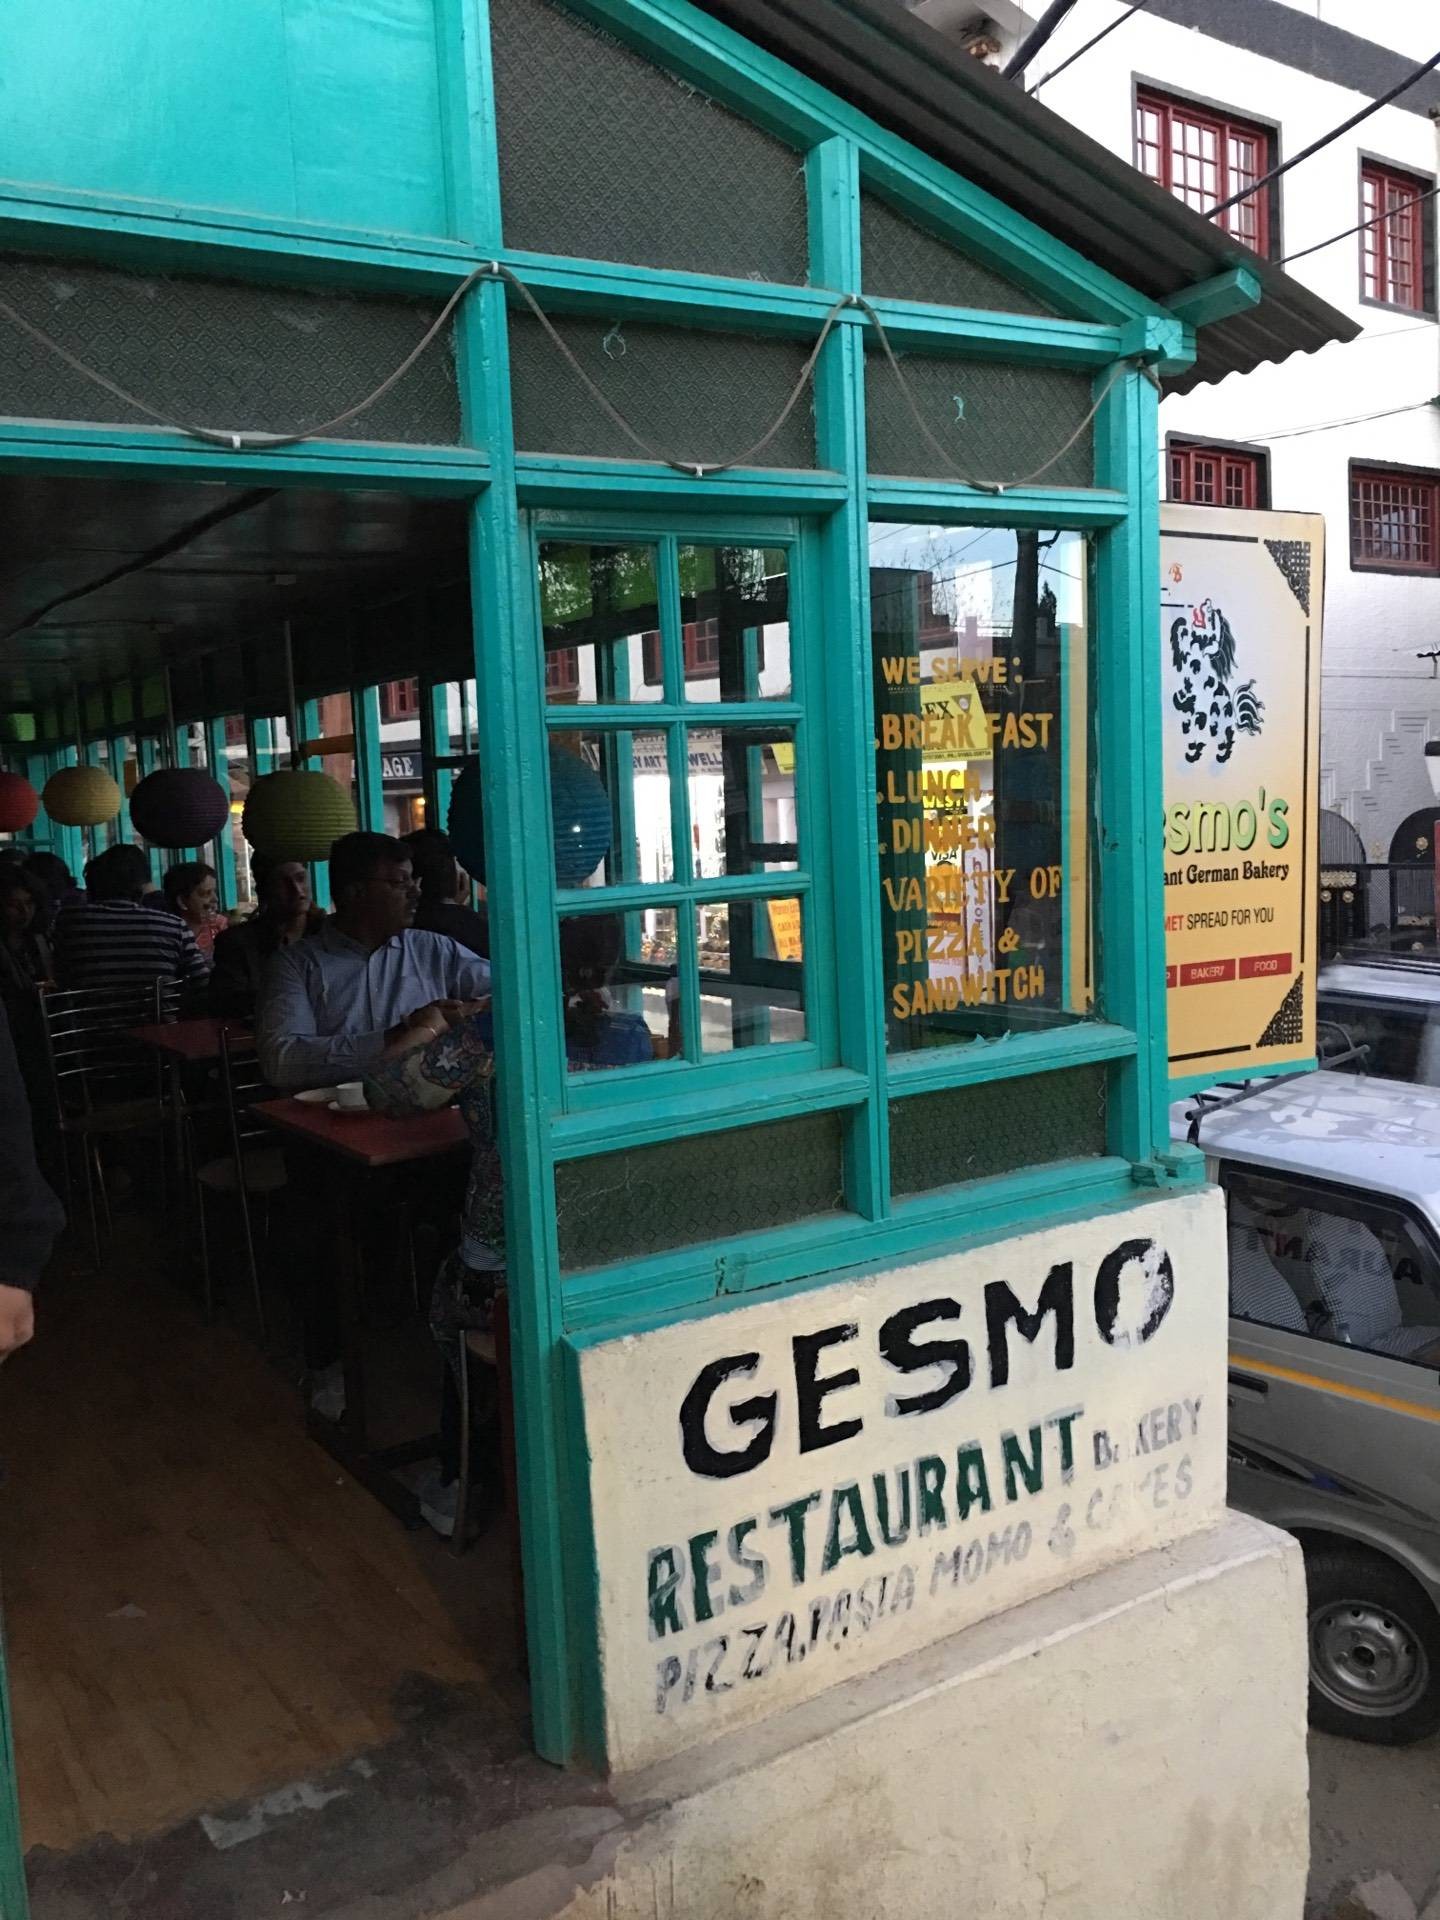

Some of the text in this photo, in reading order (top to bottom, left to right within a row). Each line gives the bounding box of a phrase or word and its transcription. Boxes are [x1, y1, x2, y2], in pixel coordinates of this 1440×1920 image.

[882, 657, 920, 684] WE
[644, 755, 662, 768] ART
[887, 768, 980, 804] LUNCH
[892, 816, 996, 854] DINNER
[1163, 786, 1289, 855] smo's
[883, 865, 1062, 912] VARIETY OF
[1187, 864, 1239, 884] German
[1242, 860, 1289, 881] Bakery
[1187, 910, 1229, 930] SPREAD
[1231, 909, 1251, 925] FOR
[1254, 907, 1274, 924] YOU
[896, 921, 1020, 965] PIZZA &
[1253, 959, 1278, 972] FOOD
[892, 965, 1045, 1020] SANDWITCH
[679, 1237, 1175, 1480] GESMO
[648, 1404, 1085, 1642] RESTAURANT
[928, 1520, 1033, 1598] MOMO
